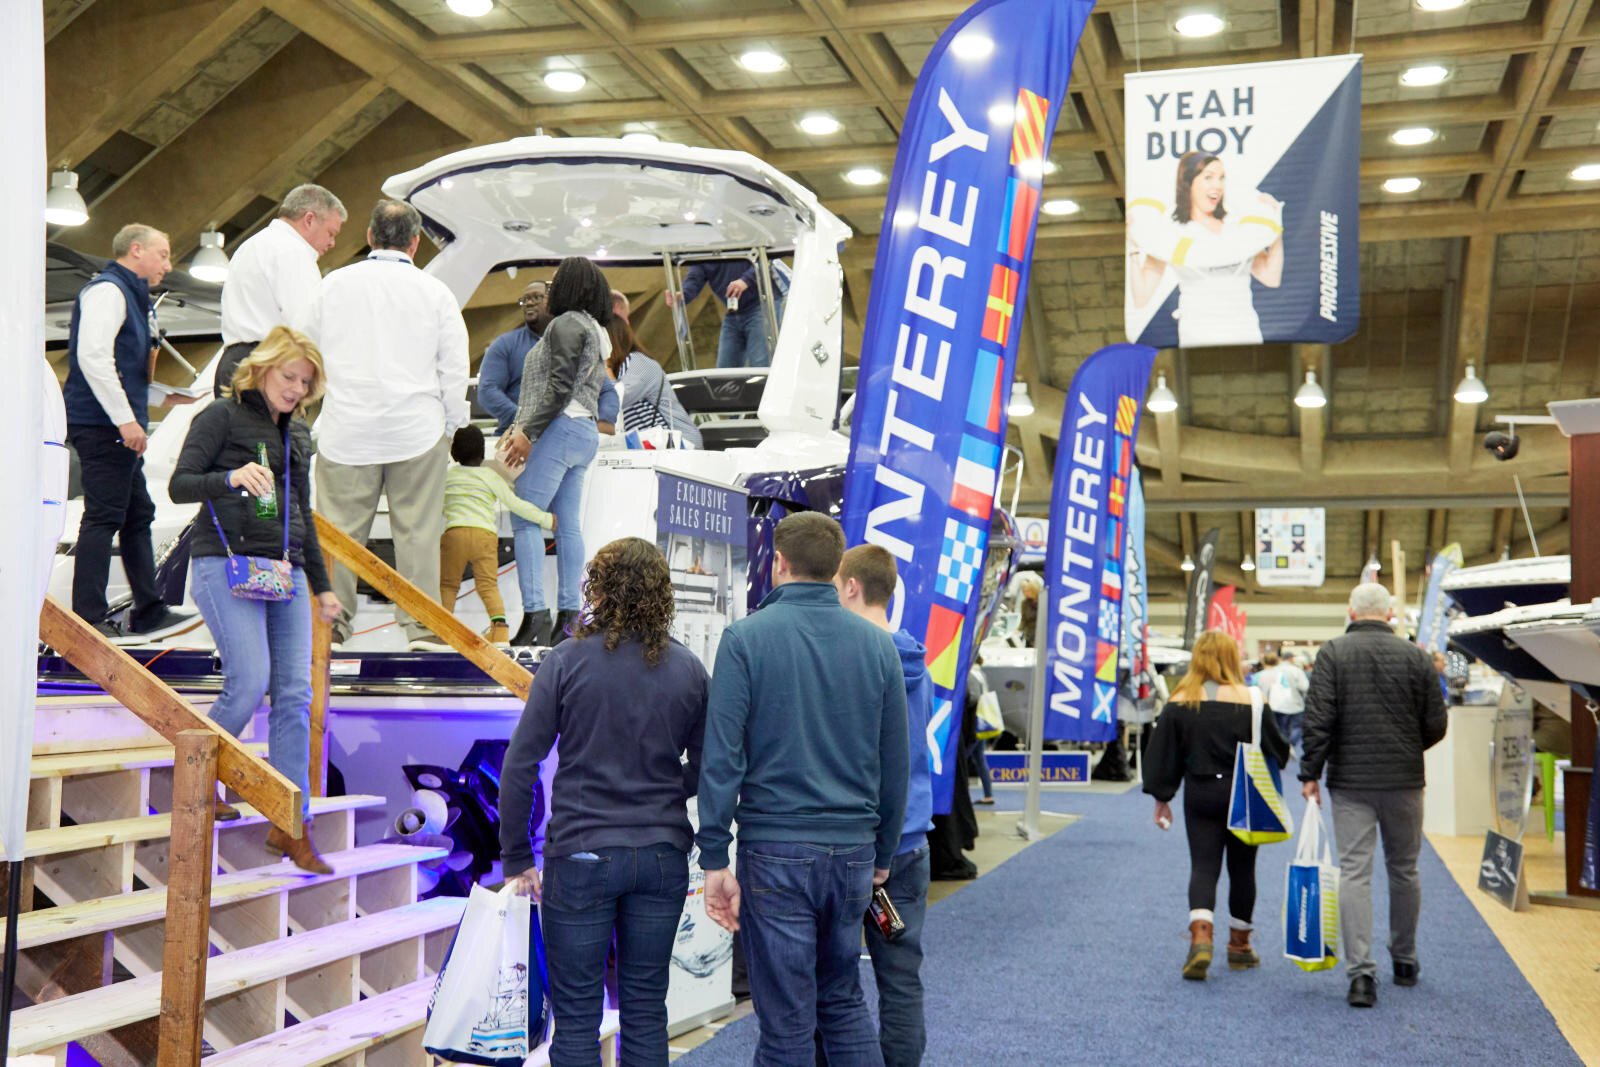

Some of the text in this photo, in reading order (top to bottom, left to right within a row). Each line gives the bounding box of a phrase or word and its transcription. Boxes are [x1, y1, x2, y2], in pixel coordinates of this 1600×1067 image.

[1146, 86, 1255, 122] YEAH
[1147, 125, 1254, 160] BUOY
[1320, 210, 1338, 322] PROGRESSIVE
[676, 481, 728, 511] EXCLUSIVE
[669, 504, 733, 535] SALES EVENT
[1050, 391, 1108, 719] MONTEREY
